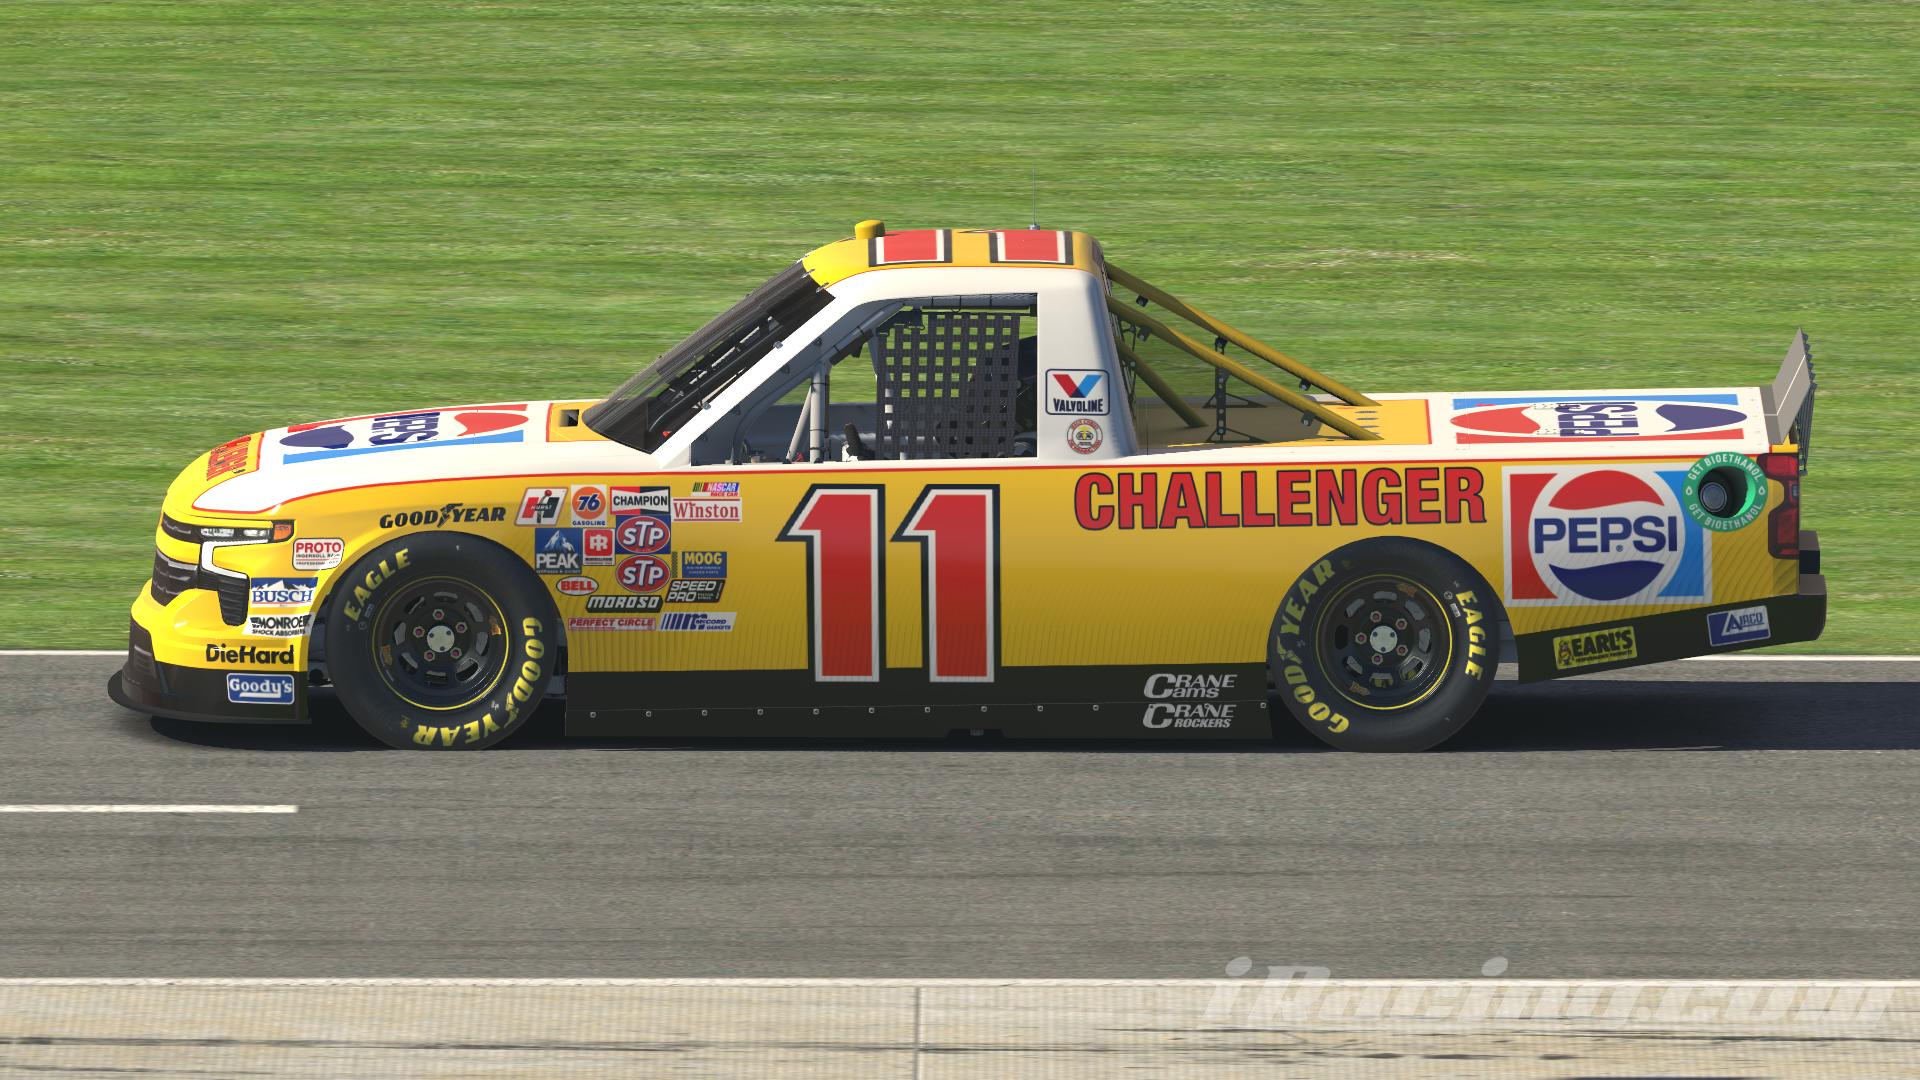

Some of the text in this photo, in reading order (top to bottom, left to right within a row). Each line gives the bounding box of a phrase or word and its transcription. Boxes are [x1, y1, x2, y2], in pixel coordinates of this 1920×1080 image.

[1053, 398, 1103, 412] VALVOLINE
[1688, 454, 1764, 482] GET BIOETHANOL
[706, 482, 737, 492] NASCAR
[578, 493, 601, 511] 76
[613, 495, 668, 506] CHAMPION
[1074, 466, 1487, 531] CHALLENGER
[379, 502, 506, 529] GOODYEAR
[673, 501, 739, 519] Winston
[1689, 503, 1763, 530] GET BIOETHANOL
[622, 520, 664, 547] STP
[1534, 515, 1678, 554] PEPSI
[295, 542, 342, 553] PROTO
[536, 553, 579, 569] PEAK
[684, 552, 722, 565] MOOG
[622, 559, 664, 586] STP
[344, 548, 411, 621] EAGLE
[561, 581, 595, 591] BELL
[670, 581, 717, 591] SPEED
[774, 483, 1001, 684] 11
[252, 590, 313, 603] BUSCH
[587, 596, 660, 609] MOROSO
[666, 592, 697, 602] PRO
[259, 616, 306, 629] MONROE
[1455, 590, 1487, 681] EAGLE
[1571, 630, 1633, 656] EARL'S
[206, 643, 294, 664] DieHard
[1272, 559, 1350, 733] GOODYEAR
[229, 678, 292, 698] Goody's
[413, 617, 545, 747] GOODYEAR
[1143, 673, 1238, 698] CRANE
[1142, 703, 1237, 728] CRANE
[1174, 718, 1232, 728] ROCKERS
